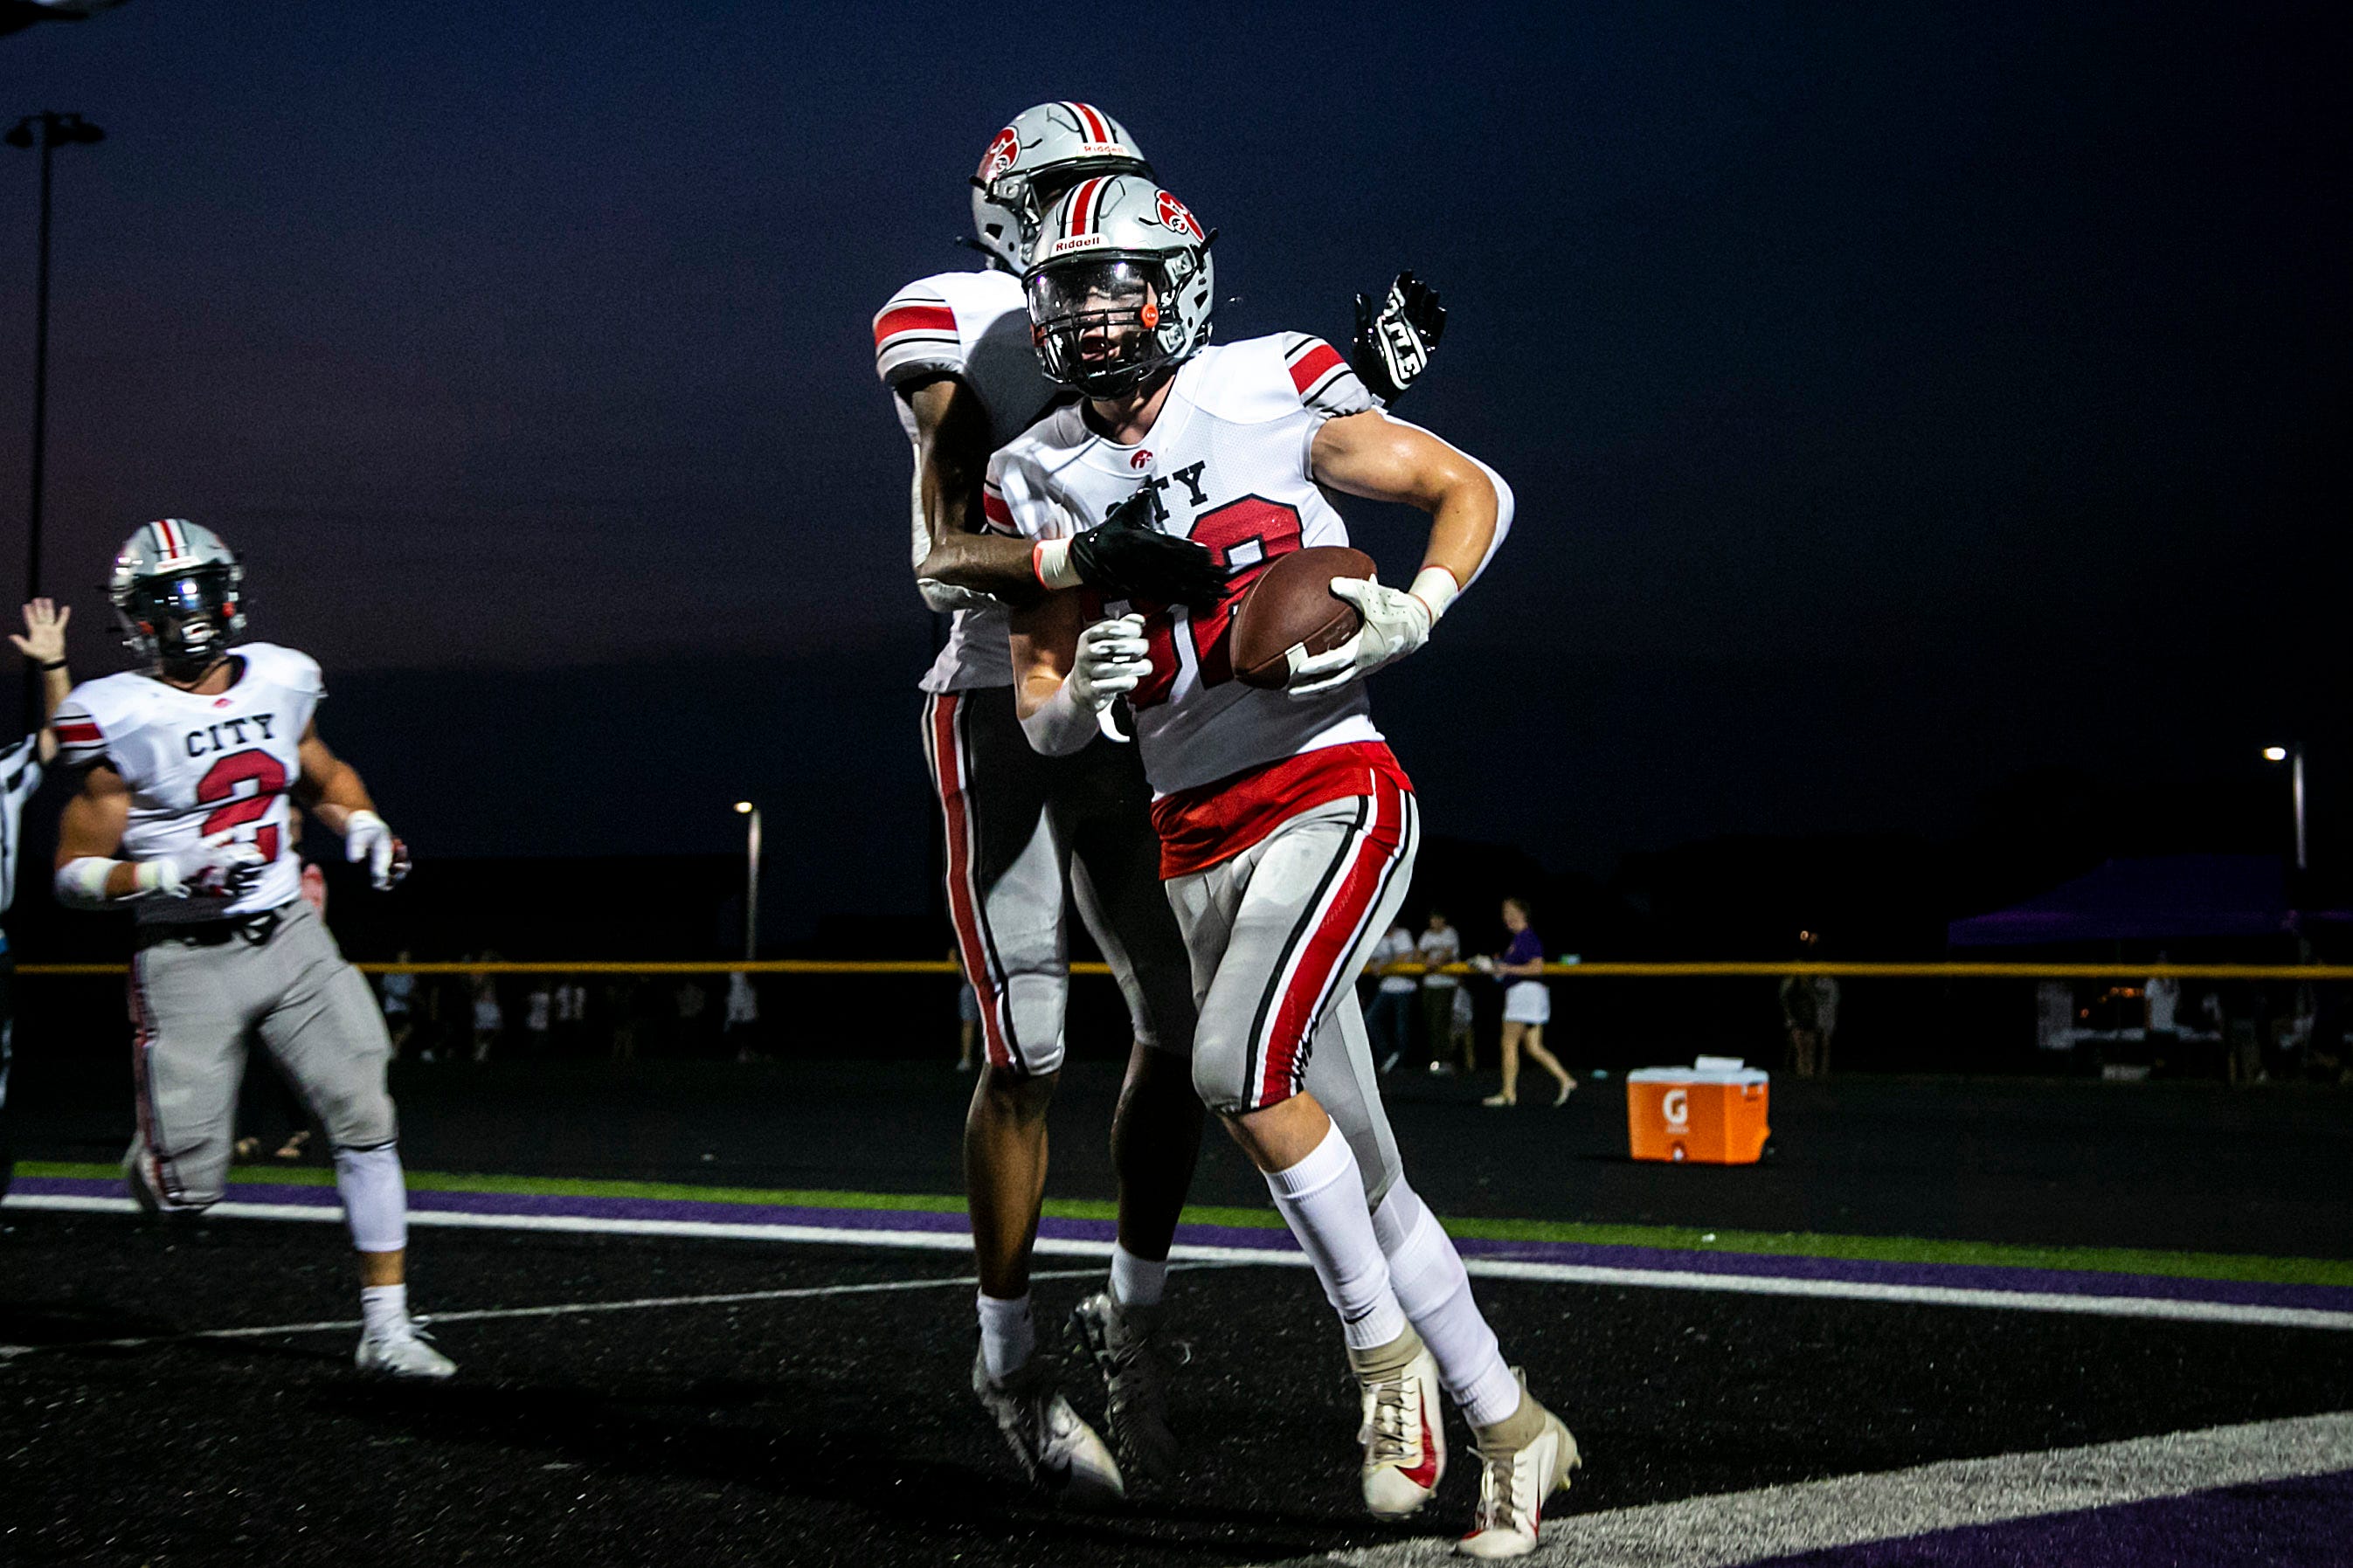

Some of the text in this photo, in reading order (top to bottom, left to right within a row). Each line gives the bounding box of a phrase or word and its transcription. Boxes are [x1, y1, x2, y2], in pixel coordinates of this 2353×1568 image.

[1055, 237, 1099, 252] Riddell
[186, 714, 274, 757] CITY
[197, 748, 284, 874] 2
[1663, 1089, 1688, 1125] G
